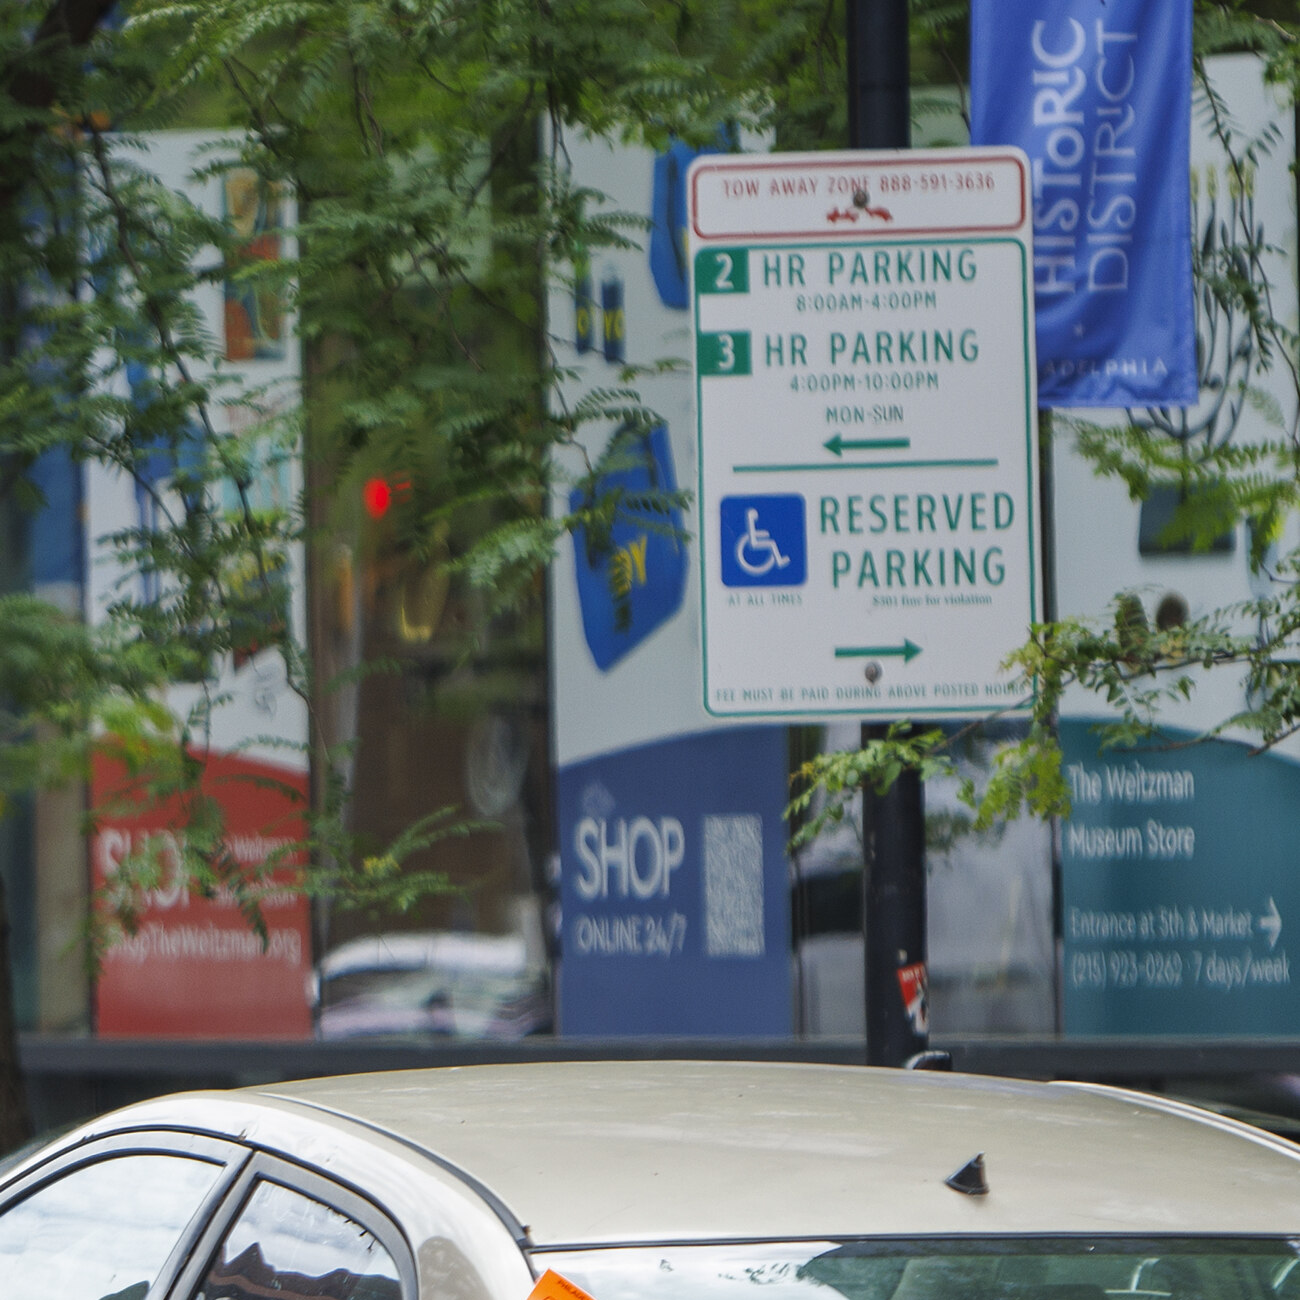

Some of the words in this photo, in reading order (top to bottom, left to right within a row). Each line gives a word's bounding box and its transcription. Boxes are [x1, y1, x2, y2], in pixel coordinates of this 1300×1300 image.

[1087, 19, 1138, 293] DISTRICT
[723, 177, 760, 198] TOW
[769, 175, 819, 197] AWAY
[827, 174, 870, 195] ZONE
[714, 253, 735, 291] 2
[763, 252, 806, 288] HR
[828, 248, 978, 285] PARKING
[795, 292, 938, 313] 8:00AM-4:00PM
[717, 334, 737, 372] 3
[764, 333, 809, 367] HR
[830, 328, 980, 364] PARKING
[790, 372, 940, 393] 4:00PM-10:00PM
[825, 405, 905, 425] MON-SUN
[820, 491, 1015, 535] RESERVED
[832, 547, 1006, 589] PARKING
[1067, 761, 1102, 803] The
[1105, 760, 1195, 802] Weitzman
[575, 816, 685, 899] SHOP
[1068, 823, 1143, 858] Museum
[1147, 818, 1196, 861] Store
[575, 914, 641, 953] ONLINE
[1070, 906, 1137, 939] Entrance
[1203, 905, 1253, 938] Market
